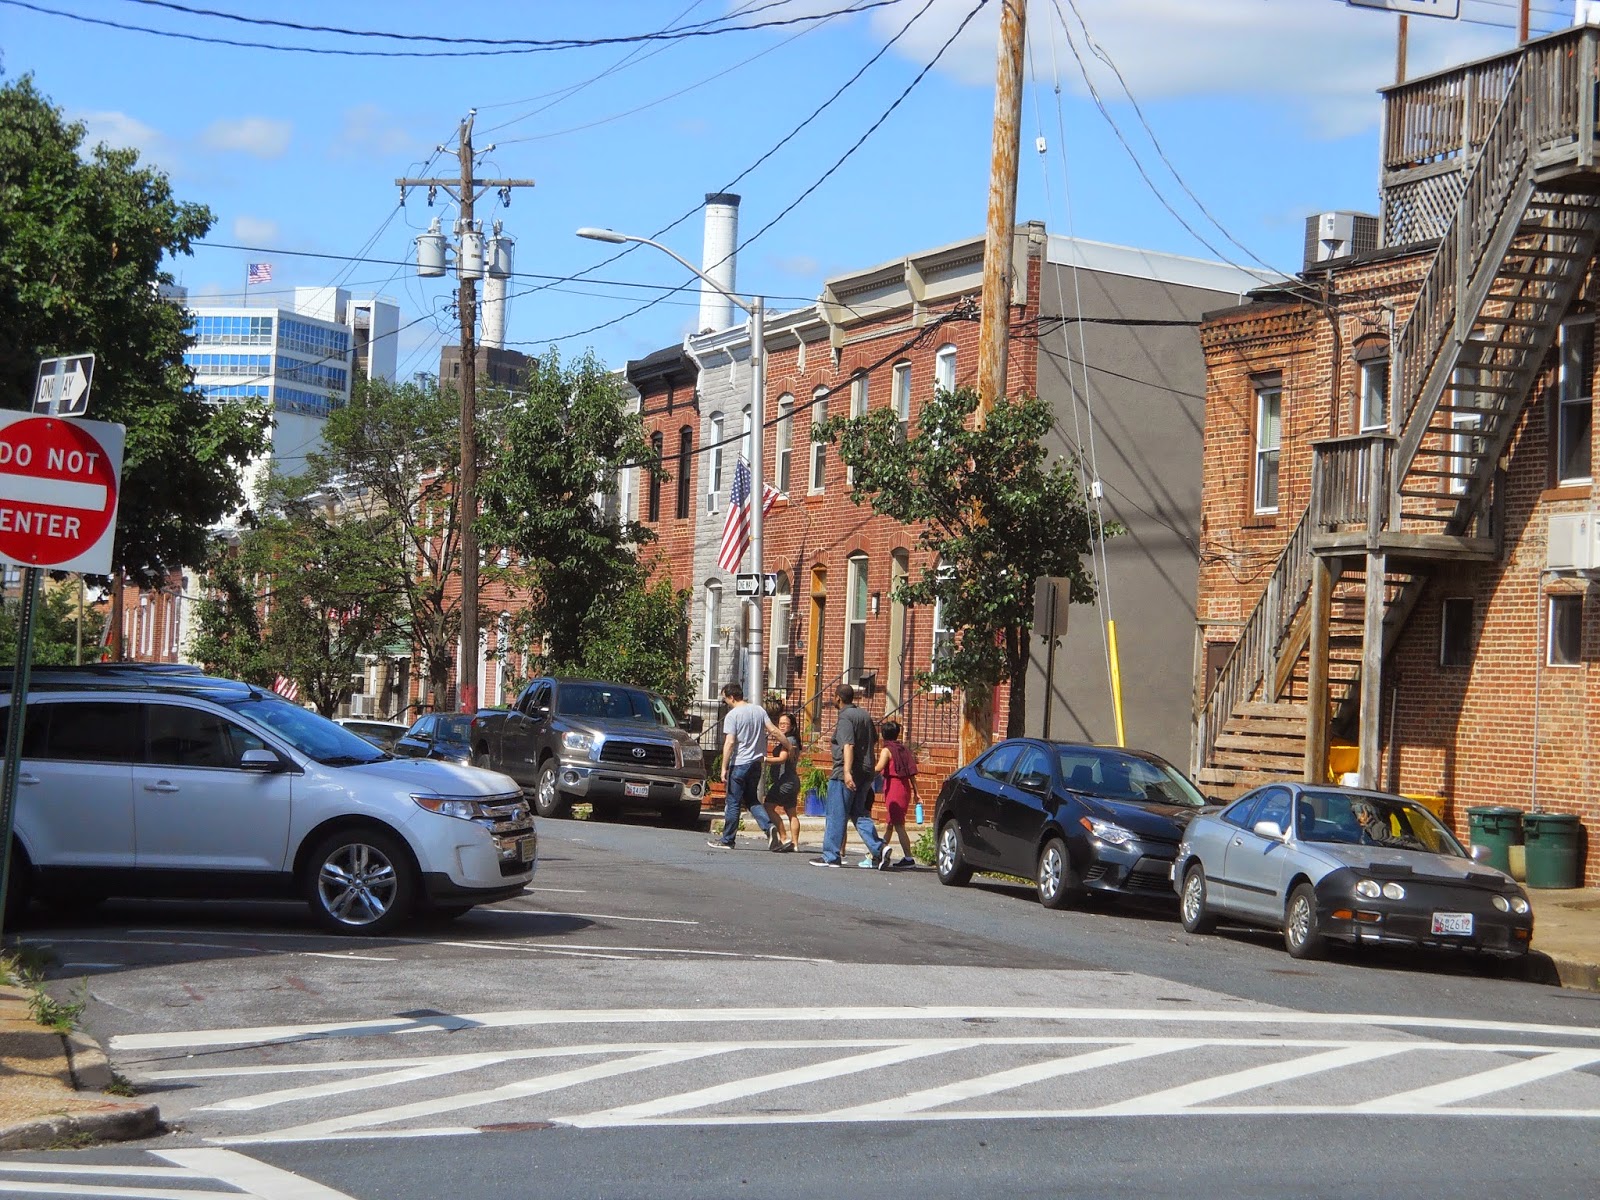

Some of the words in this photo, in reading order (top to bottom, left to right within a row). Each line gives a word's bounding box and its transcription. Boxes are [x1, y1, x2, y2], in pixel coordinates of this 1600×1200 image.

[0, 441, 32, 466] DO
[47, 447, 99, 474] NOT
[0, 508, 80, 539] ENTER
